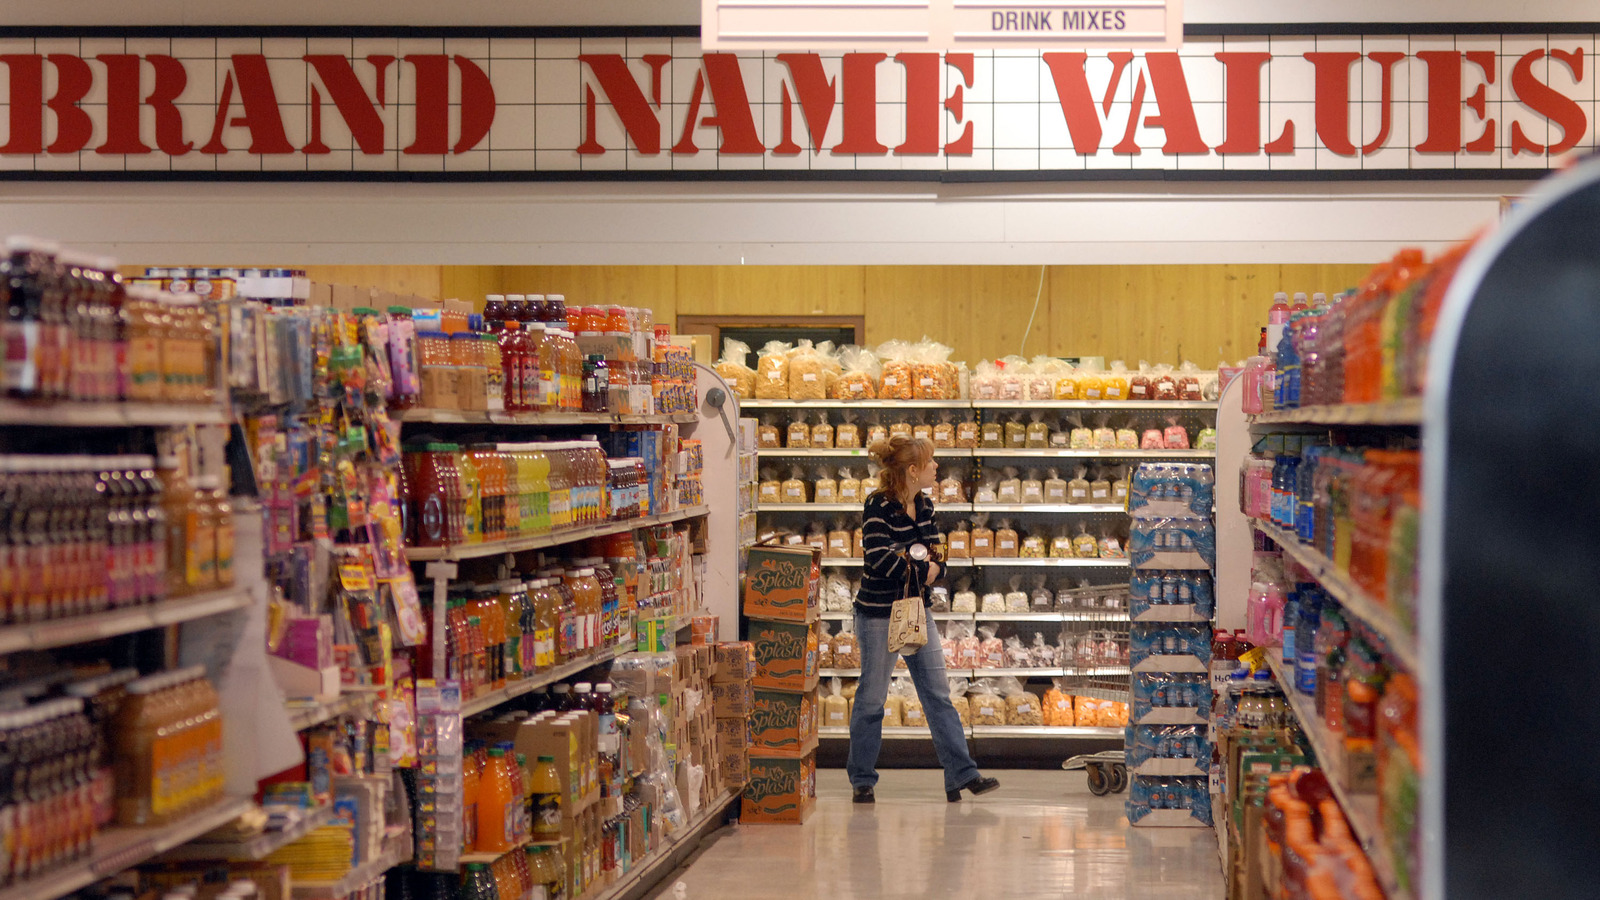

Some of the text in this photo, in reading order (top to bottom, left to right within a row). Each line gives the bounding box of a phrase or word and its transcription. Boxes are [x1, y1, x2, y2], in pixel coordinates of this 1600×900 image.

[991, 10, 1126, 31] DRINK MIXES
[0, 47, 1588, 156] BRAND NAME VALUES
[756, 568, 803, 593] Splash
[754, 638, 802, 663] Splash
[751, 708, 798, 734] Splash
[748, 775, 795, 801] Splash
